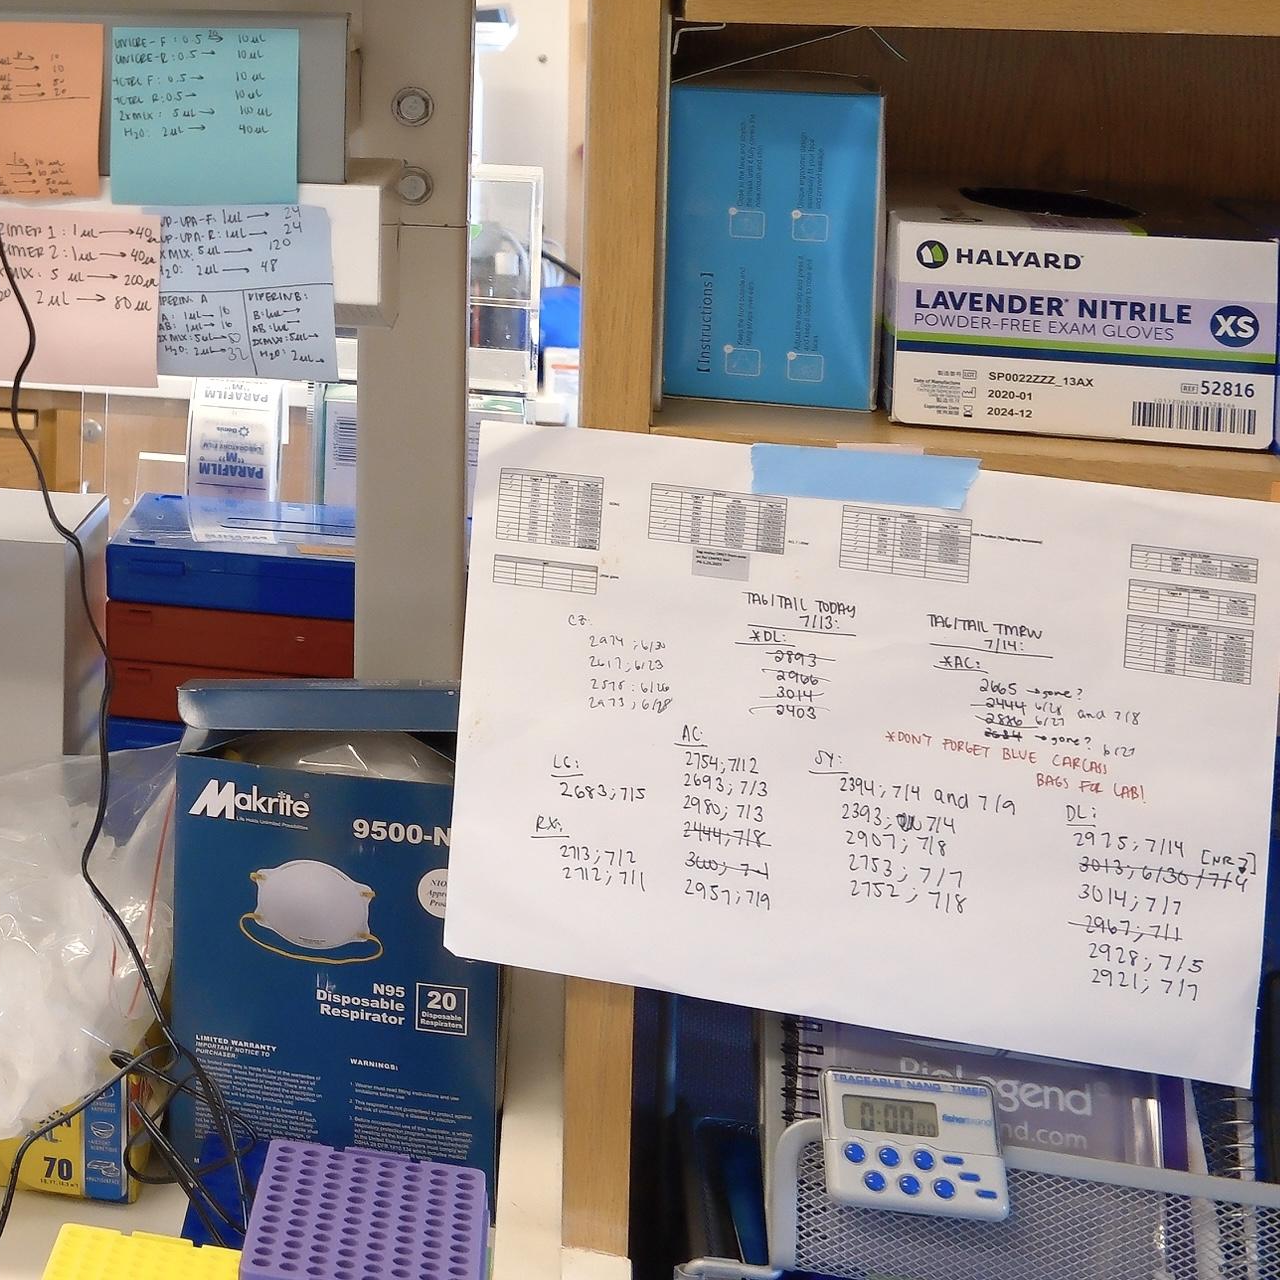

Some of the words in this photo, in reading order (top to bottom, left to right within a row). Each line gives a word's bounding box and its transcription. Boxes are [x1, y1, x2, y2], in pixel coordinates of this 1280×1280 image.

[269, 238, 291, 251] 120
[261, 258, 278, 272] 48
[956, 247, 1084, 270] HALYARD
[915, 289, 1069, 317] LAVENDER
[1078, 298, 1192, 324] NITRILE
[1215, 313, 1256, 339] XS
[914, 312, 1041, 333] POWDER-FREE
[1048, 321, 1096, 337] EXAM
[1102, 323, 1175, 342] GLOVES
[988, 371, 1094, 388] SP0022ZZZ_13AX
[988, 389, 1033, 401] 2020-01
[1200, 380, 1255, 398] 52816
[987, 406, 1033, 418] 2024-12
[199, 462, 263, 479] PARAFILM
[815, 600, 856, 618] TODAY
[993, 623, 1042, 640] TMRW
[979, 678, 1018, 696] 2665
[942, 738, 990, 758] FORGET
[1002, 747, 1038, 764] BLUE
[1052, 753, 1108, 775] CARCASS
[1036, 773, 1070, 789] BAGS
[934, 789, 969, 810] and
[373, 983, 406, 998] N95
[316, 989, 405, 1012] Disposable
[427, 990, 457, 1011] 20
[320, 1003, 405, 1026] Respirator
[420, 1018, 463, 1029] Respirators
[421, 1011, 462, 1021] Disposable
[195, 1034, 229, 1046] LIMITED
[231, 1039, 277, 1052] WARRANTY
[195, 1041, 233, 1052] IMPORTANT
[234, 1047, 259, 1056] NOTICE
[261, 1050, 270, 1058] TO
[350, 1058, 399, 1071] WARNINGS:
[832, 1074, 902, 1089] TRACEABLE
[906, 1080, 941, 1092] NANO
[952, 1086, 987, 1096] TIMER
[42, 1156, 73, 1180] 70
